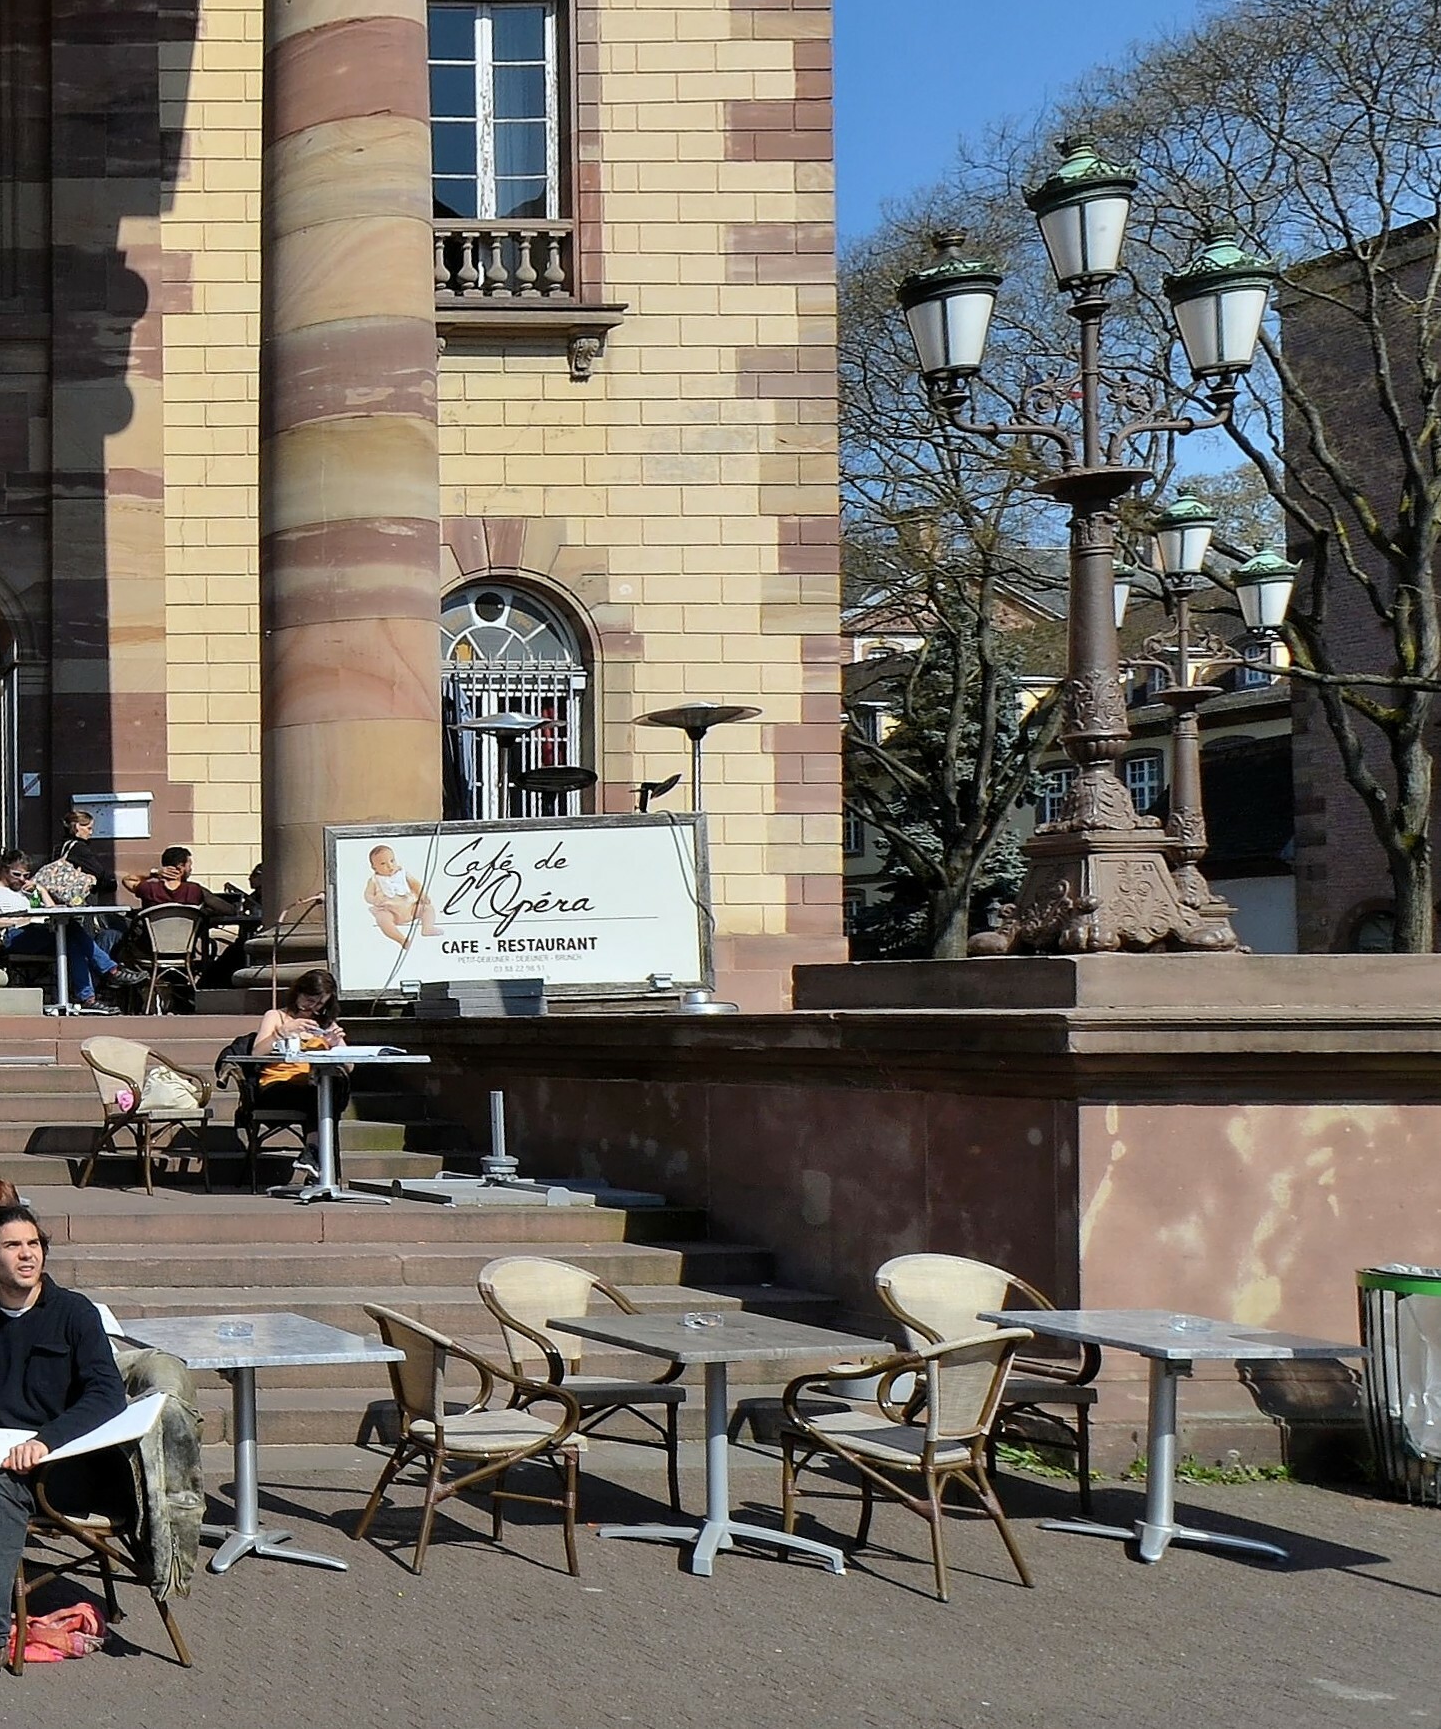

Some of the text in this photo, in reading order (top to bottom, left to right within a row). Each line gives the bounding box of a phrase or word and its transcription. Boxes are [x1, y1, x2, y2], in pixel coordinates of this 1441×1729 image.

[444, 837, 569, 889] Café de
[441, 940, 479, 954] CAFE
[497, 937, 598, 952] RESTAURANT
